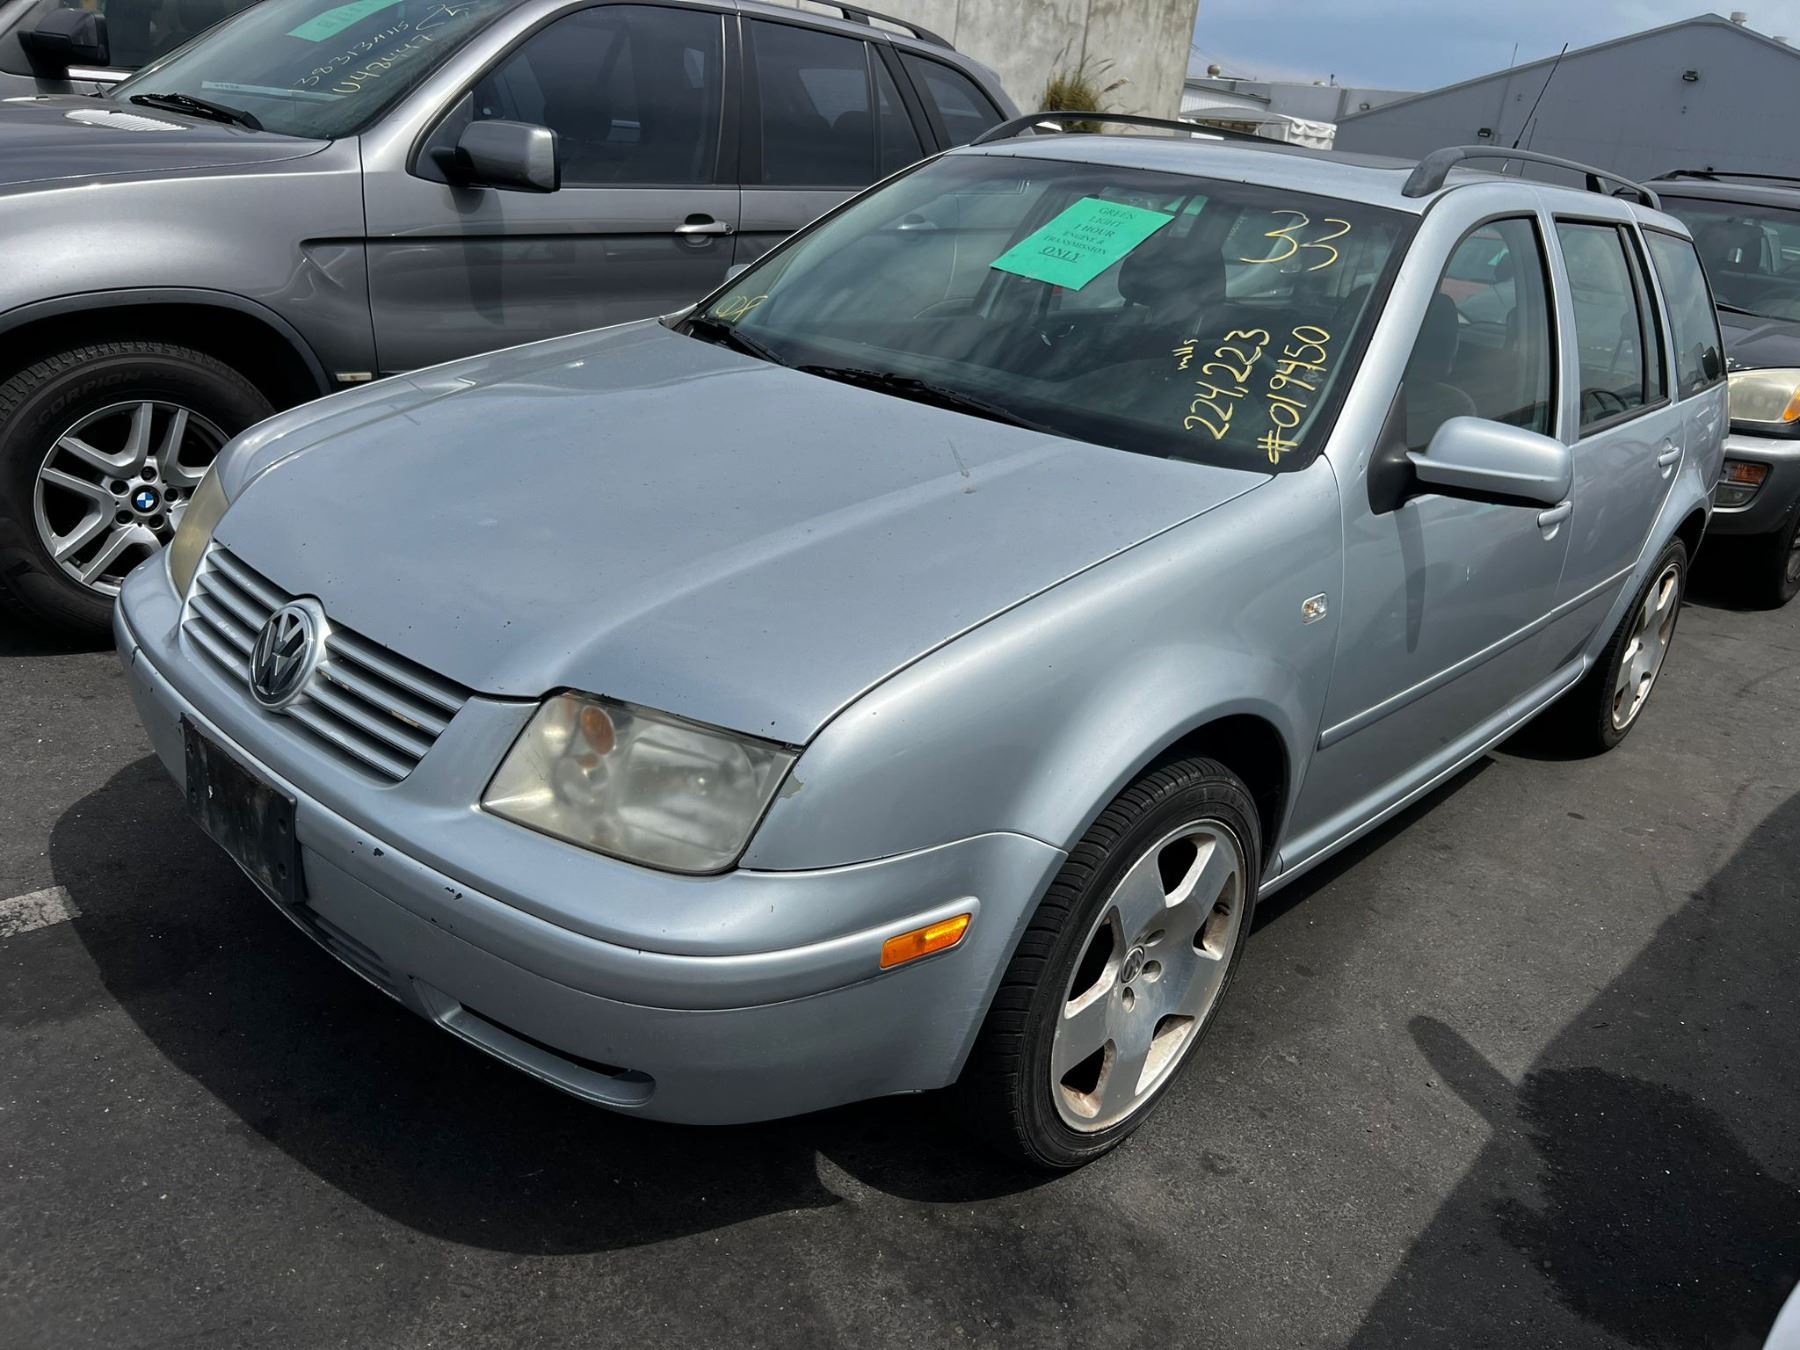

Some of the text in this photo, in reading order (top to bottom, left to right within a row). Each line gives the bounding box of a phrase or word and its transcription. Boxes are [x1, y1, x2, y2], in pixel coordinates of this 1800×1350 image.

[1099, 207, 1136, 220] GREEN
[1088, 215, 1125, 228] LIGHT
[1082, 224, 1116, 238] HOUR
[1240, 209, 1352, 272] 33
[1041, 246, 1085, 262] ONLY
